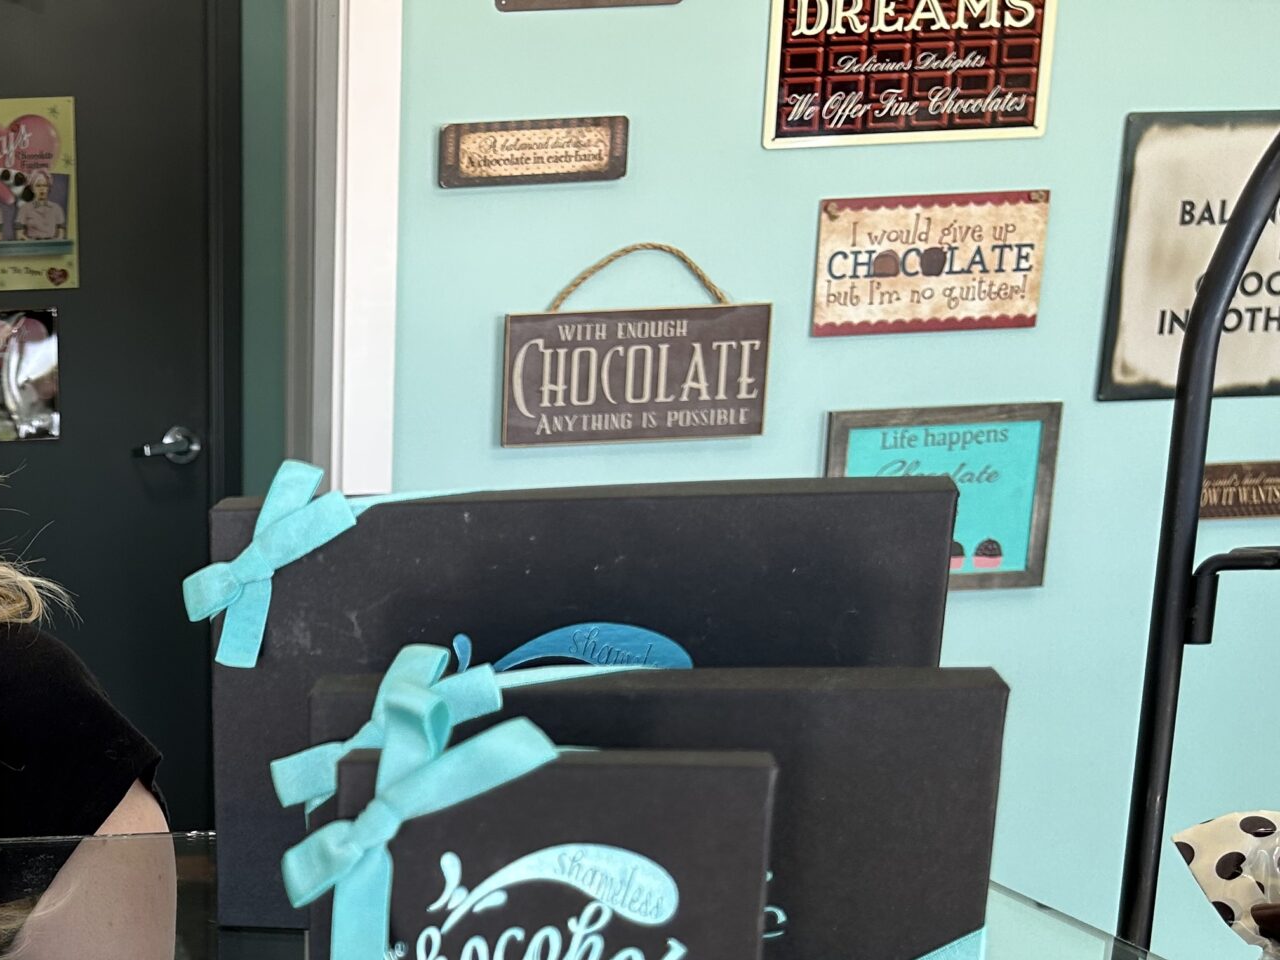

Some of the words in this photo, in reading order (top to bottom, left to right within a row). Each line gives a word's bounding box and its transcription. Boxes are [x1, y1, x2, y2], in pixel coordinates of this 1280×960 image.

[792, 0, 1036, 36] DREAMS
[914, 51, 986, 75] Delights
[788, 93, 819, 121] We
[822, 91, 871, 129] Offer
[874, 88, 919, 117] Fine
[927, 85, 1026, 116] Chocolates
[533, 152, 545, 165] in
[851, 222, 859, 247] I
[867, 213, 932, 246] would
[938, 219, 984, 248] give
[993, 222, 1017, 243] up
[827, 243, 1035, 281] CHCLATE
[826, 280, 860, 308] but
[869, 281, 902, 305] I'm
[910, 286, 935, 304] no
[558, 323, 608, 342] WITH
[617, 319, 689, 339] ENOUGH
[512, 337, 762, 419] CHOCOLATE
[535, 412, 633, 436] ANYTHING
[642, 411, 658, 428] IS
[666, 407, 750, 428] POSSIBLE
[880, 430, 919, 450] Life
[923, 427, 1009, 451] happens
[874, 458, 1001, 484] Chlate
